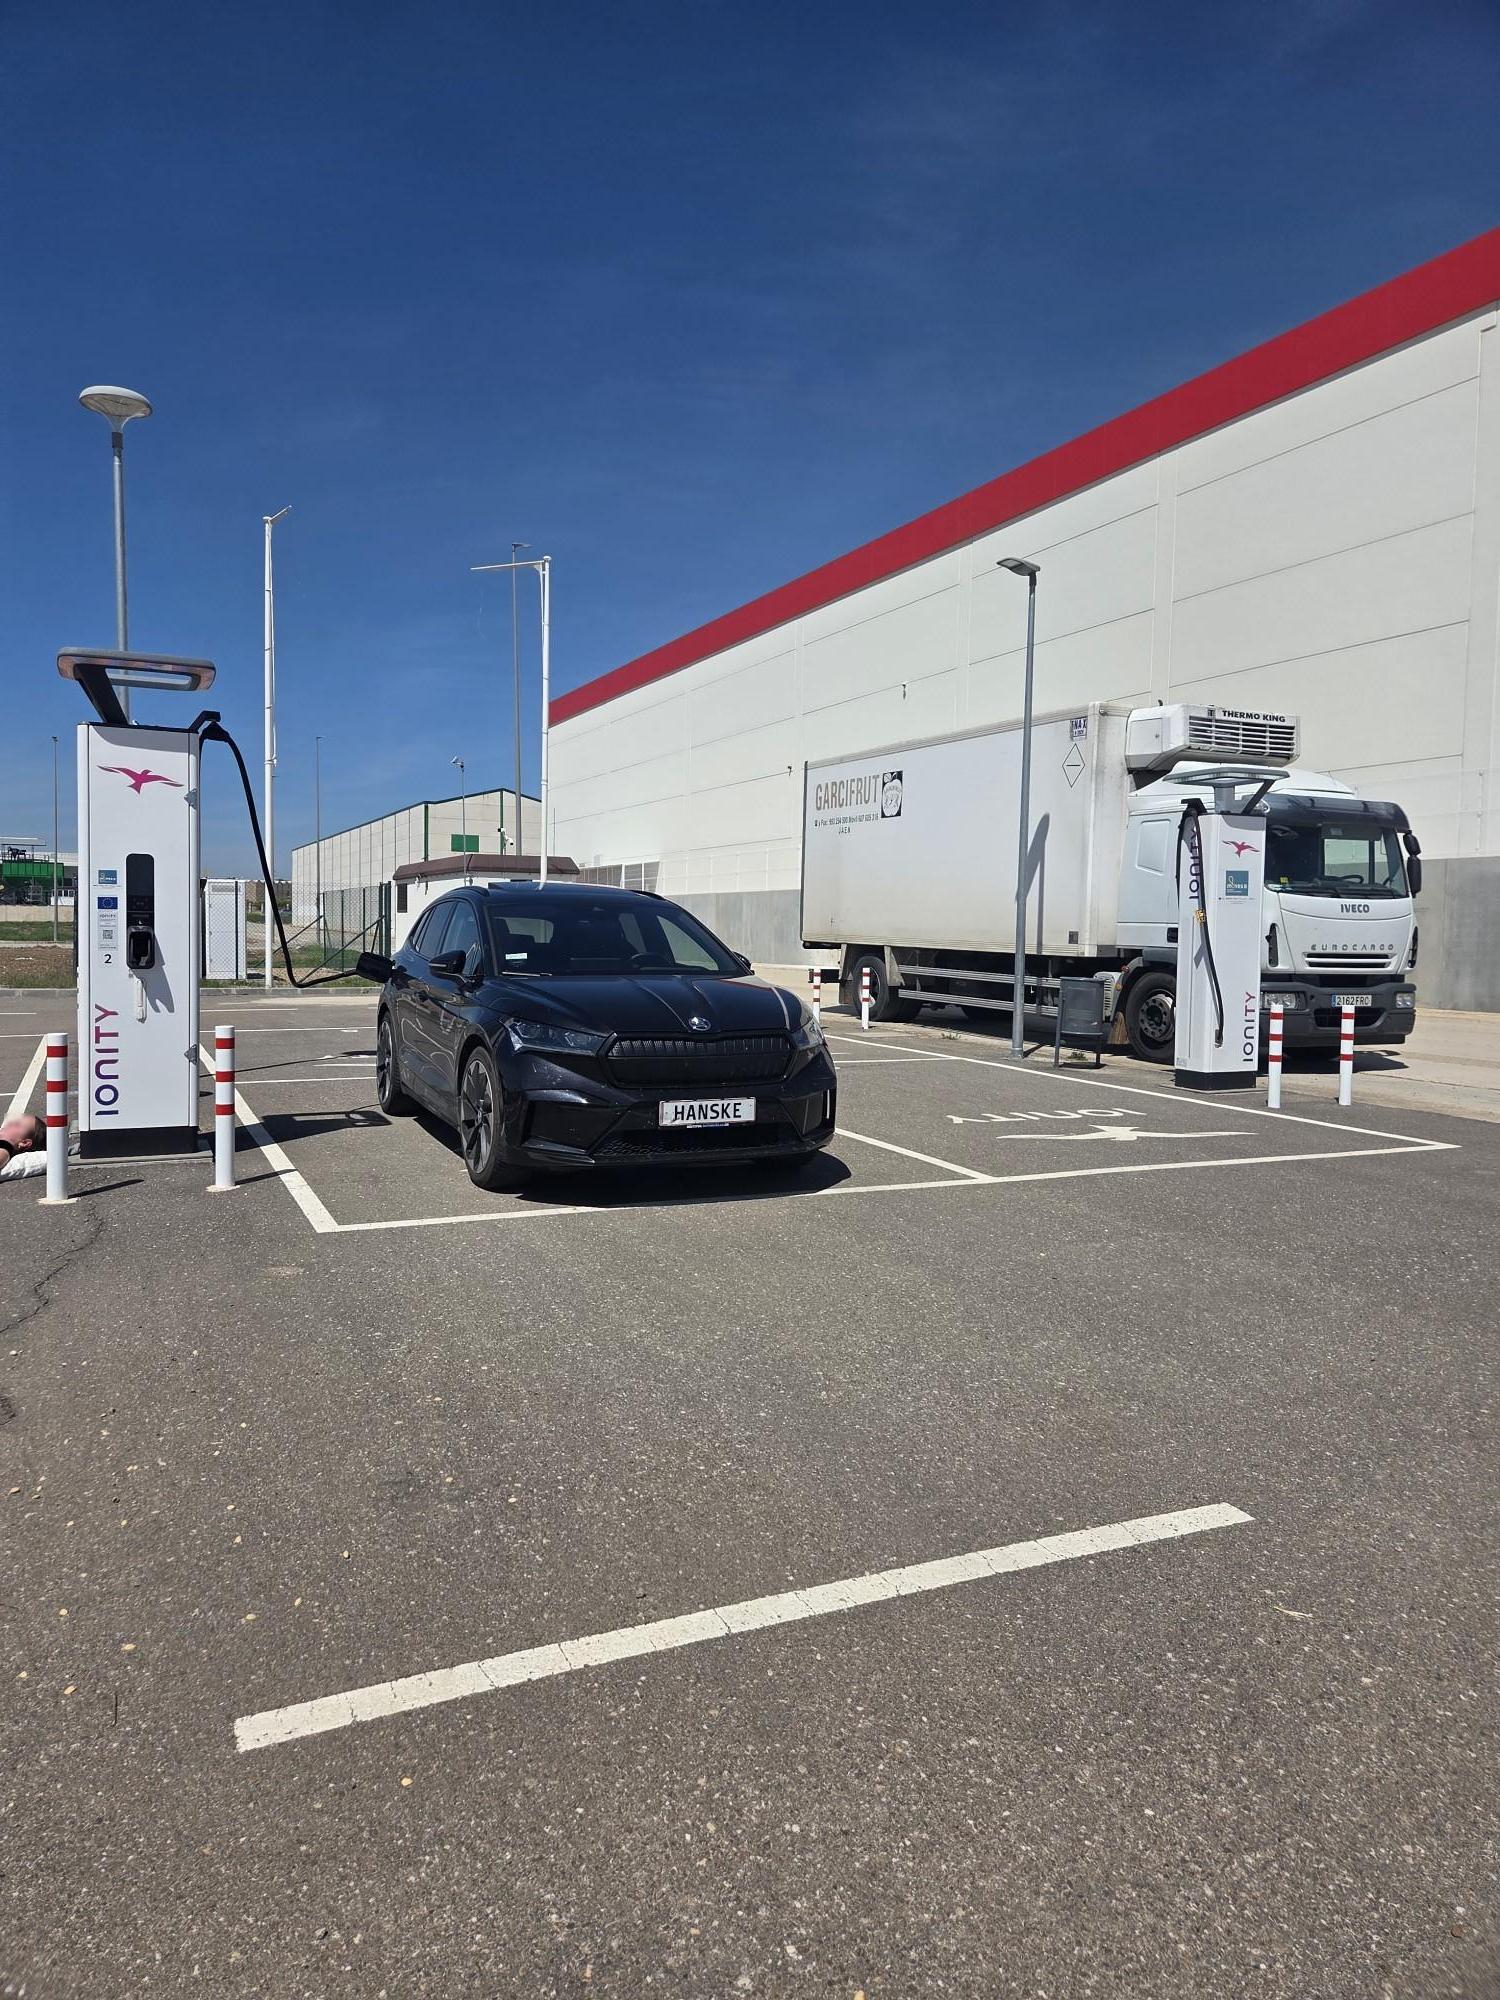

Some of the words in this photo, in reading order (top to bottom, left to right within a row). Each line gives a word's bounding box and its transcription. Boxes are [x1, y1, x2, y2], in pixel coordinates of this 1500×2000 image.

[1222, 710, 1260, 720] THERMO
[1263, 714, 1286, 723] KING
[815, 774, 880, 811] GARCIFRUT
[1340, 903, 1370, 913] IVECO
[1310, 943, 1394, 951] EUROCARGO
[103, 953, 112, 964] 2
[1242, 991, 1256, 1062] IONITY
[95, 1003, 119, 1116] IONITY
[674, 1102, 742, 1121] HANSKE
[946, 1107, 1147, 1124] IONITY
